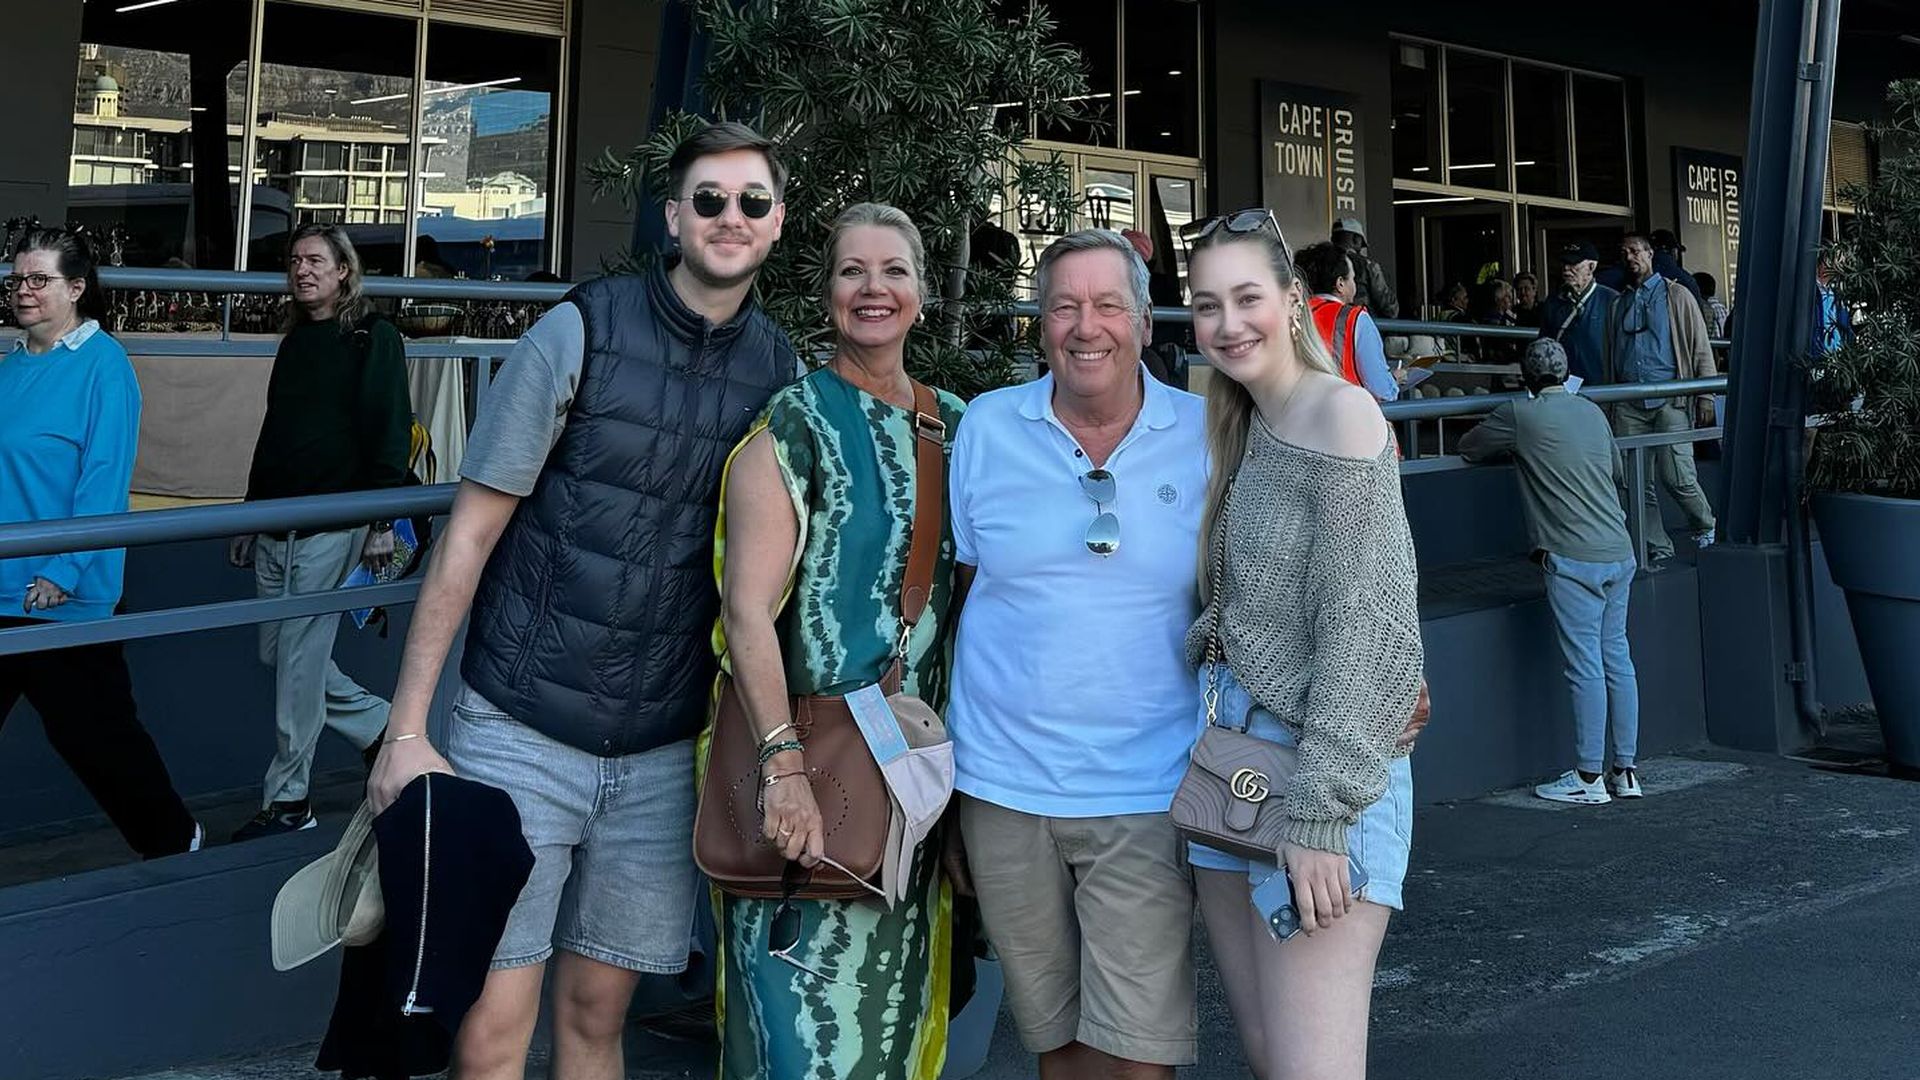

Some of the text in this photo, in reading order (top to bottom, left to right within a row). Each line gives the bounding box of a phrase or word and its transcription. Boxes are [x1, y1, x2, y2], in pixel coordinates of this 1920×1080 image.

[1279, 102, 1322, 138] CAPE
[1274, 141, 1323, 178] TOWN
[1334, 109, 1356, 211] CRUISE
[1688, 164, 1718, 193] CAPE
[1686, 196, 1719, 225] TOWN
[1724, 169, 1740, 251] CRUISE
